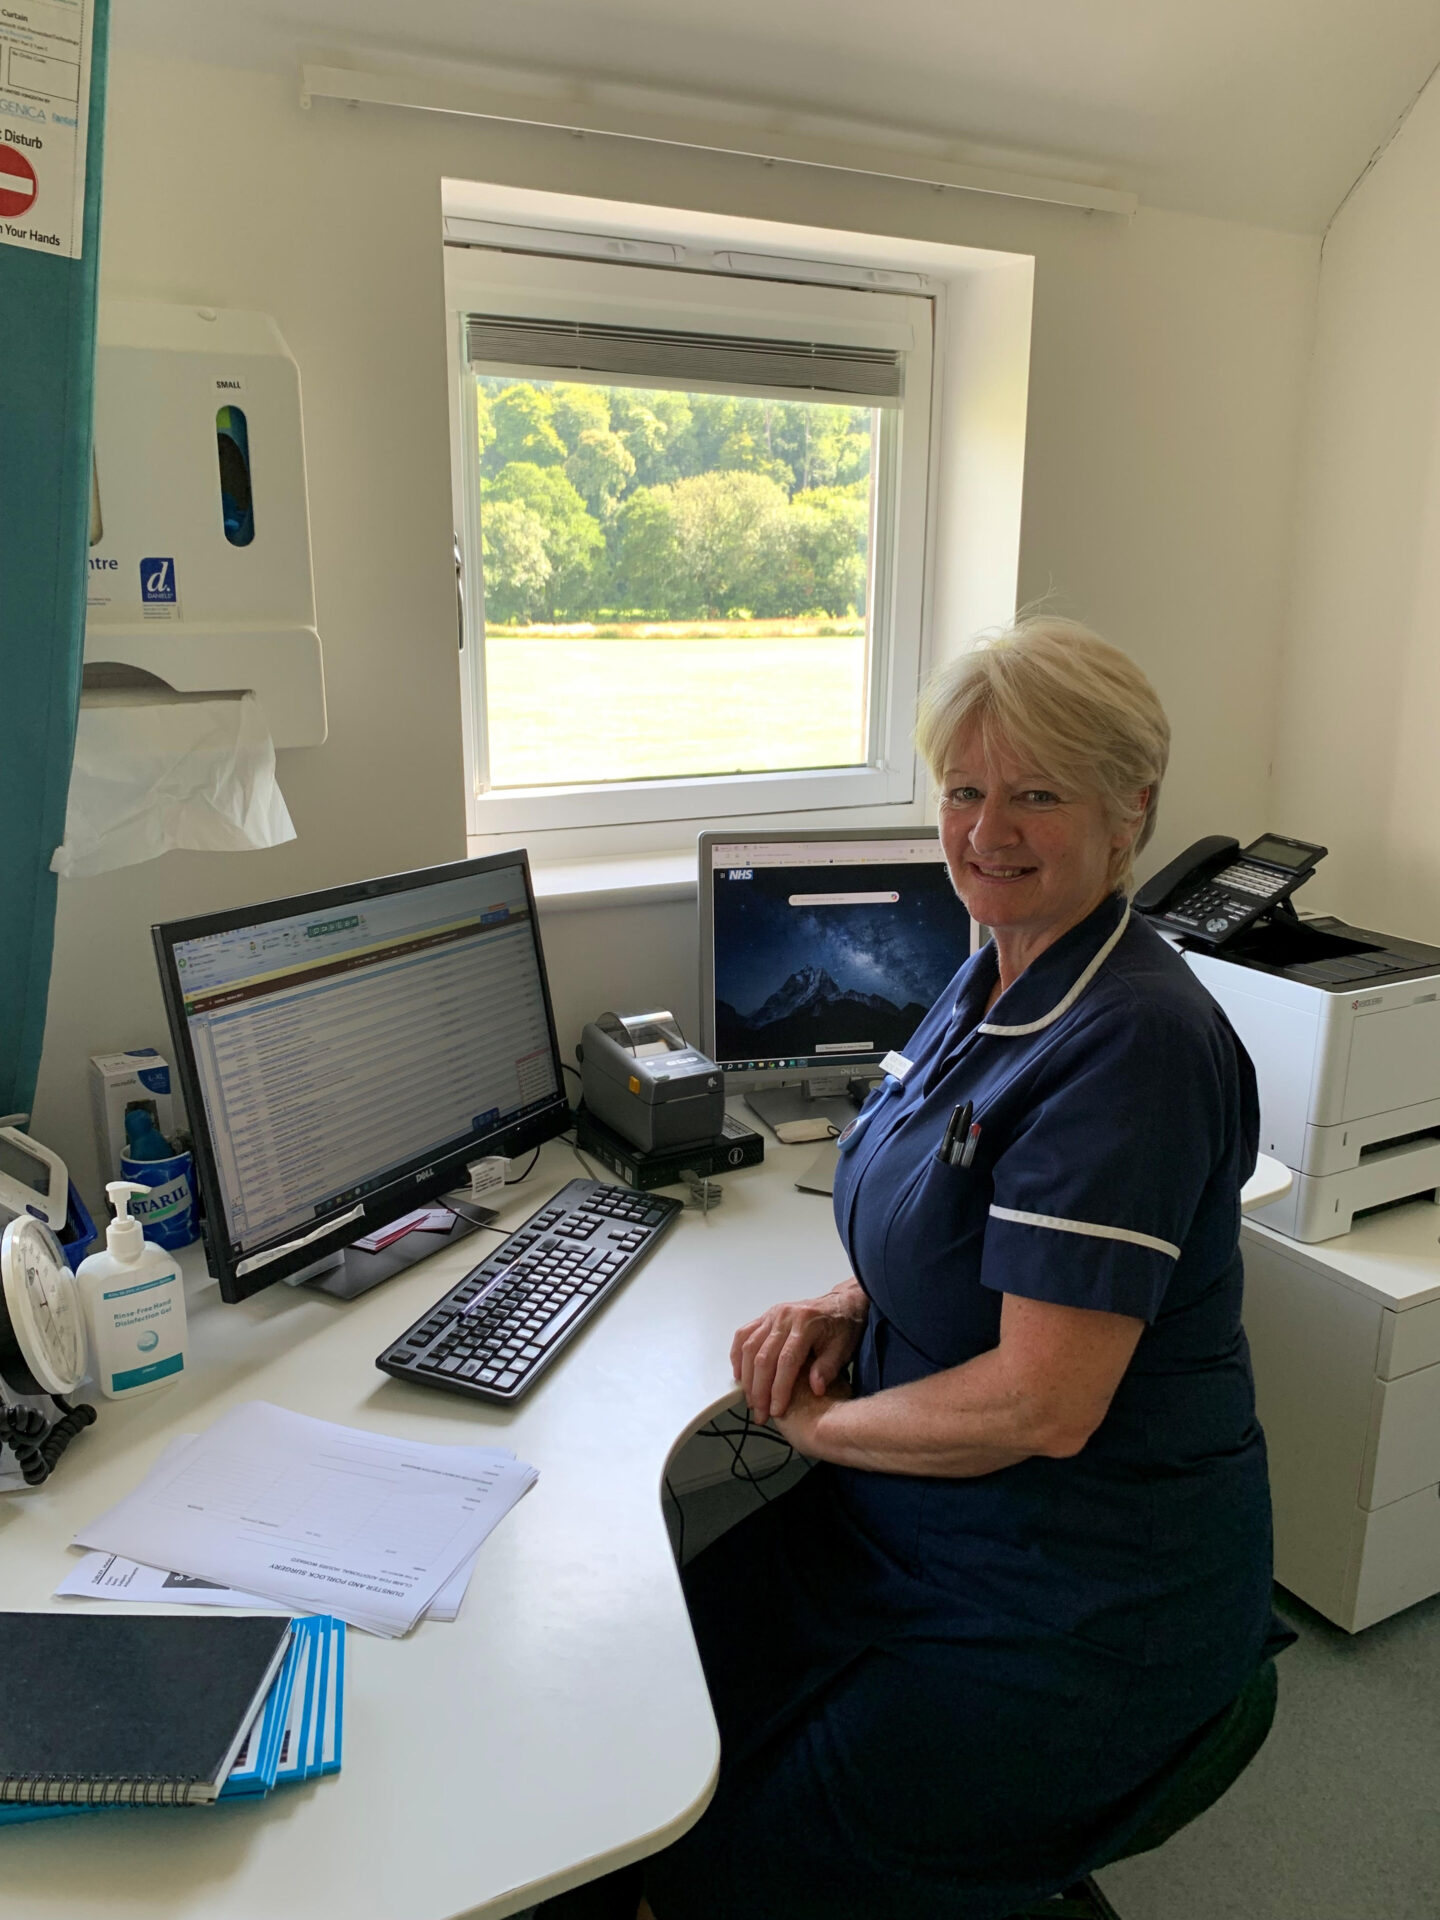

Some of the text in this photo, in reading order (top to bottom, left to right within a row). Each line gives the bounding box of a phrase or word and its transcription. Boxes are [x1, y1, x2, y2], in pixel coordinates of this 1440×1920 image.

[1, 9, 28, 21] Curtain
[4, 129, 43, 149] Disturb
[5, 223, 27, 239] Your
[29, 229, 60, 246] Hands
[216, 380, 241, 389] SMALL
[89, 557, 118, 570] ntre
[729, 870, 752, 880] NHS
[415, 1167, 435, 1183] DELL
[132, 1186, 188, 1215] STARIL
[153, 1299, 172, 1309] Hand
[115, 1307, 172, 1328] Disinfection Gel
[268, 1563, 405, 1597] DUNSTER AND PORLOCK SURGERY
